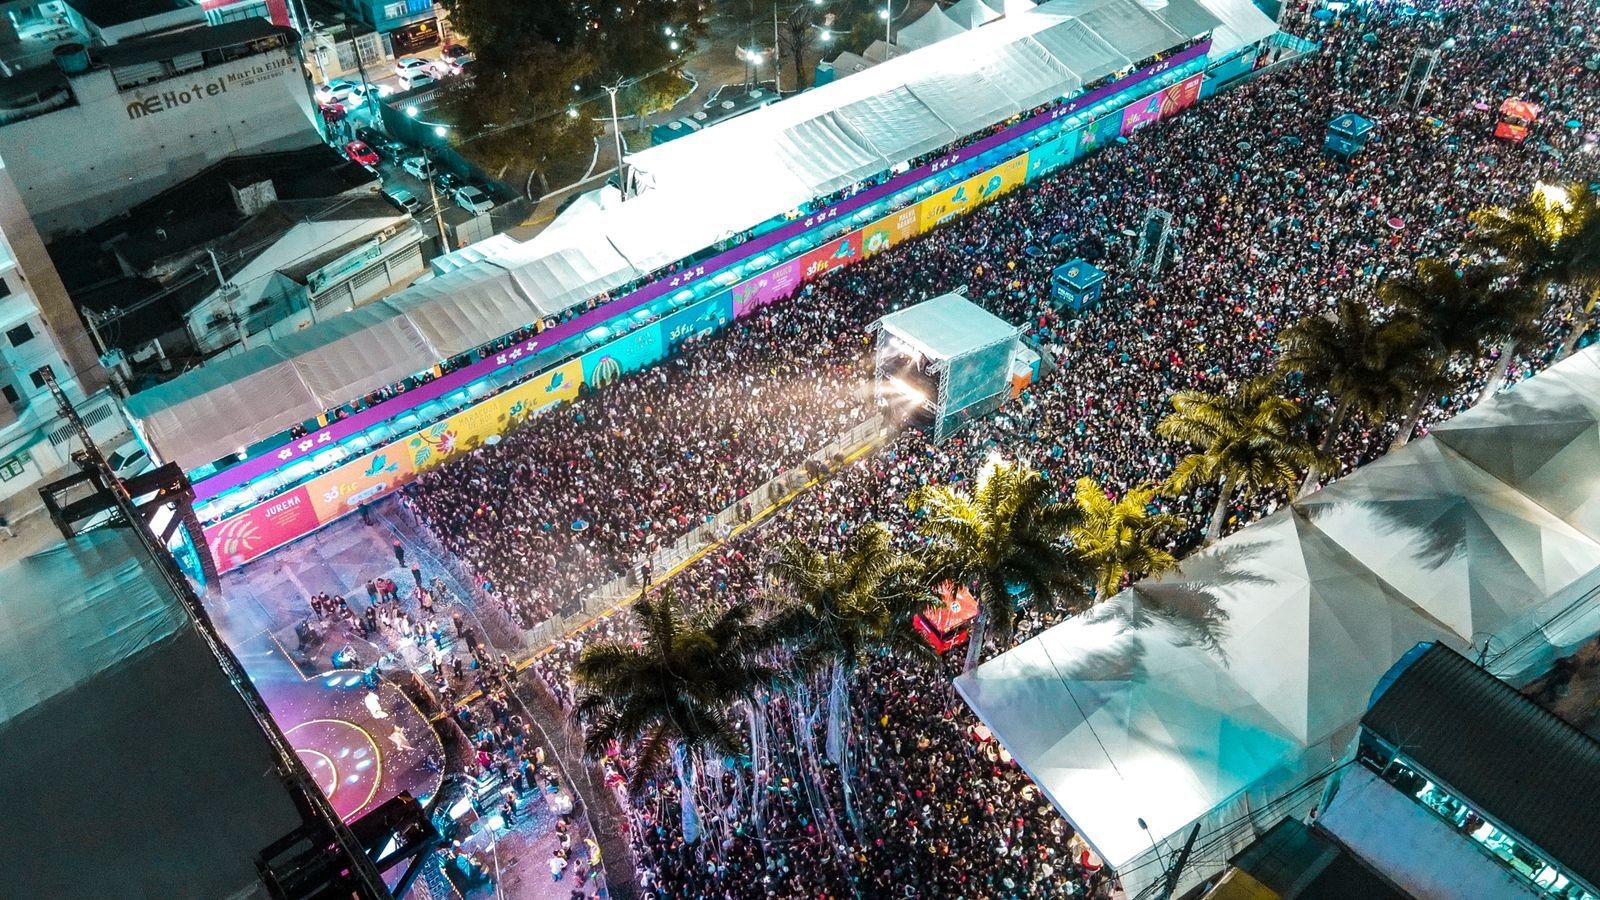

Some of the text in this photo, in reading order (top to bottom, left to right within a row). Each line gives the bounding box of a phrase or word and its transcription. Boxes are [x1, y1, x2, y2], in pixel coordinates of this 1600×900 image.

[227, 66, 263, 83] Maria
[162, 77, 227, 110] Hotel
[264, 495, 301, 518] JUREMA
